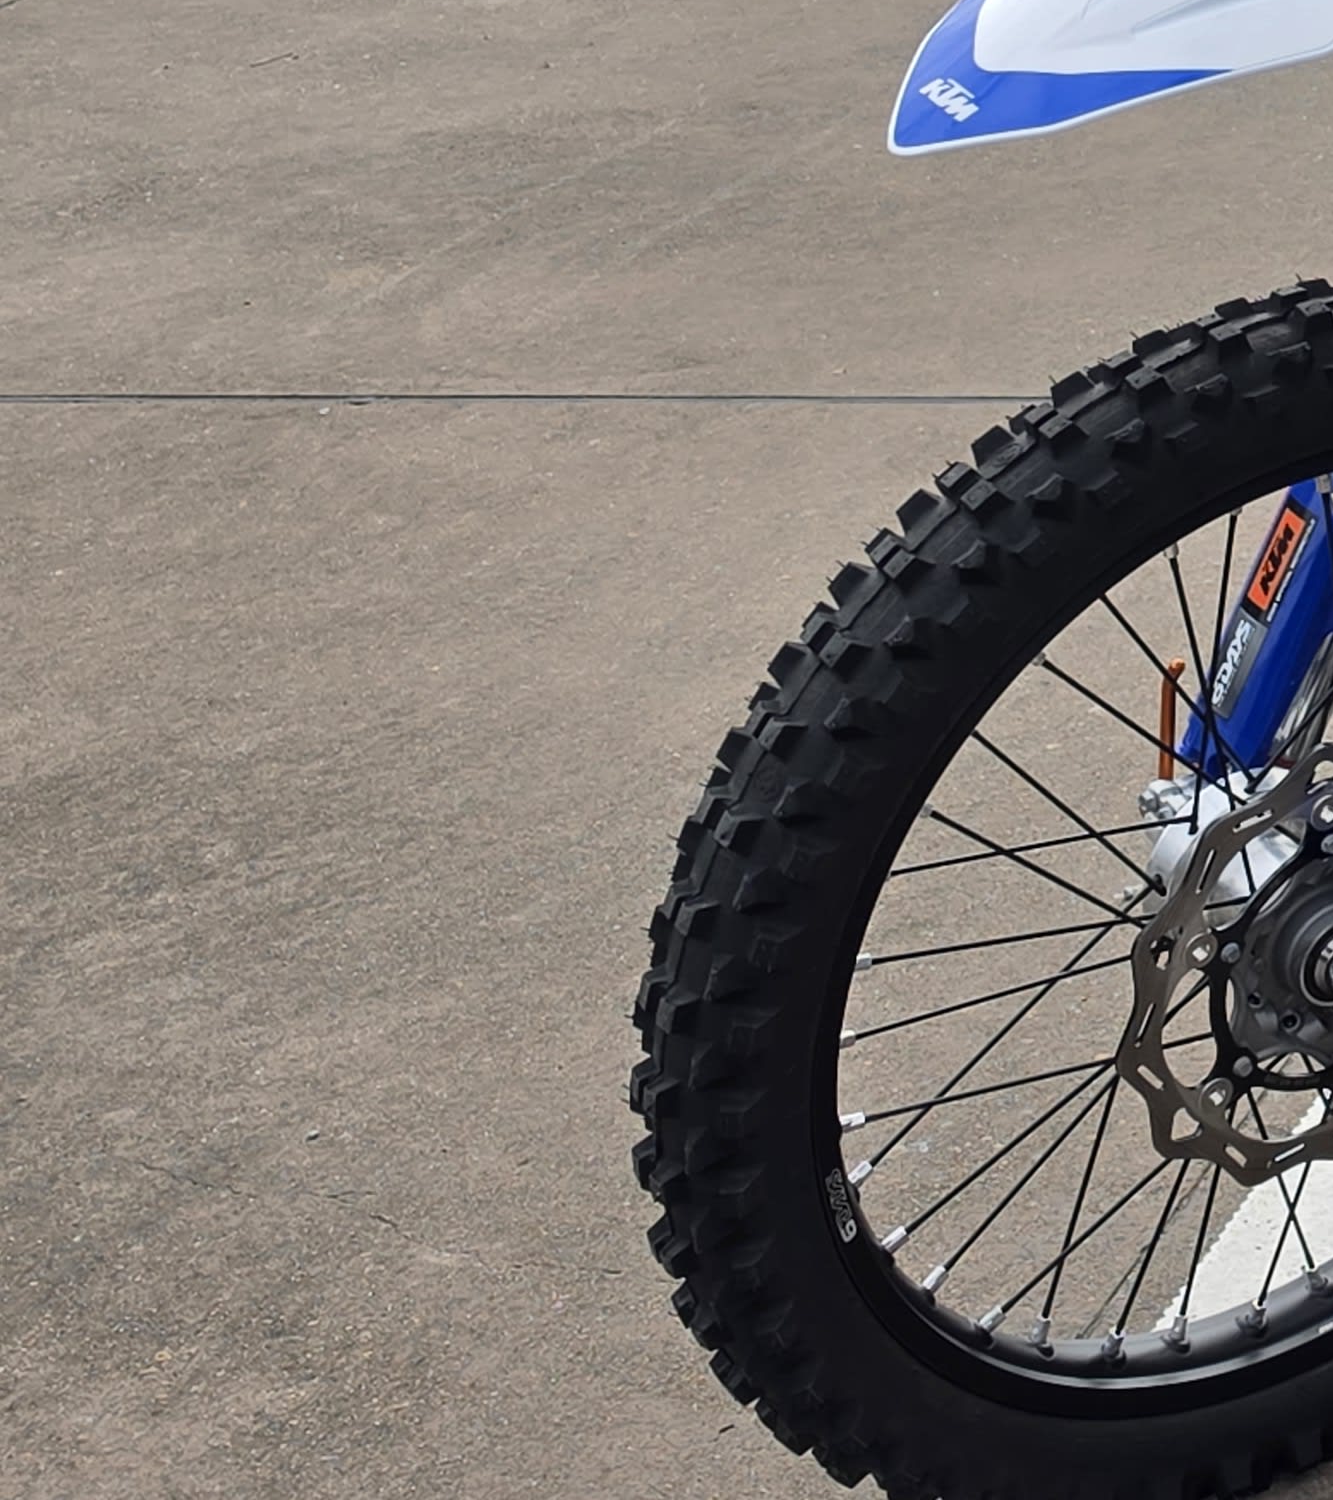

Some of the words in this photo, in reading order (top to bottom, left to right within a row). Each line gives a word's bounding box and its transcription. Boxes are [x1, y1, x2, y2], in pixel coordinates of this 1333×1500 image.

[919, 78, 980, 122] KTM
[1258, 523, 1295, 597] KTM
[1211, 618, 1252, 707] 6DAYS
